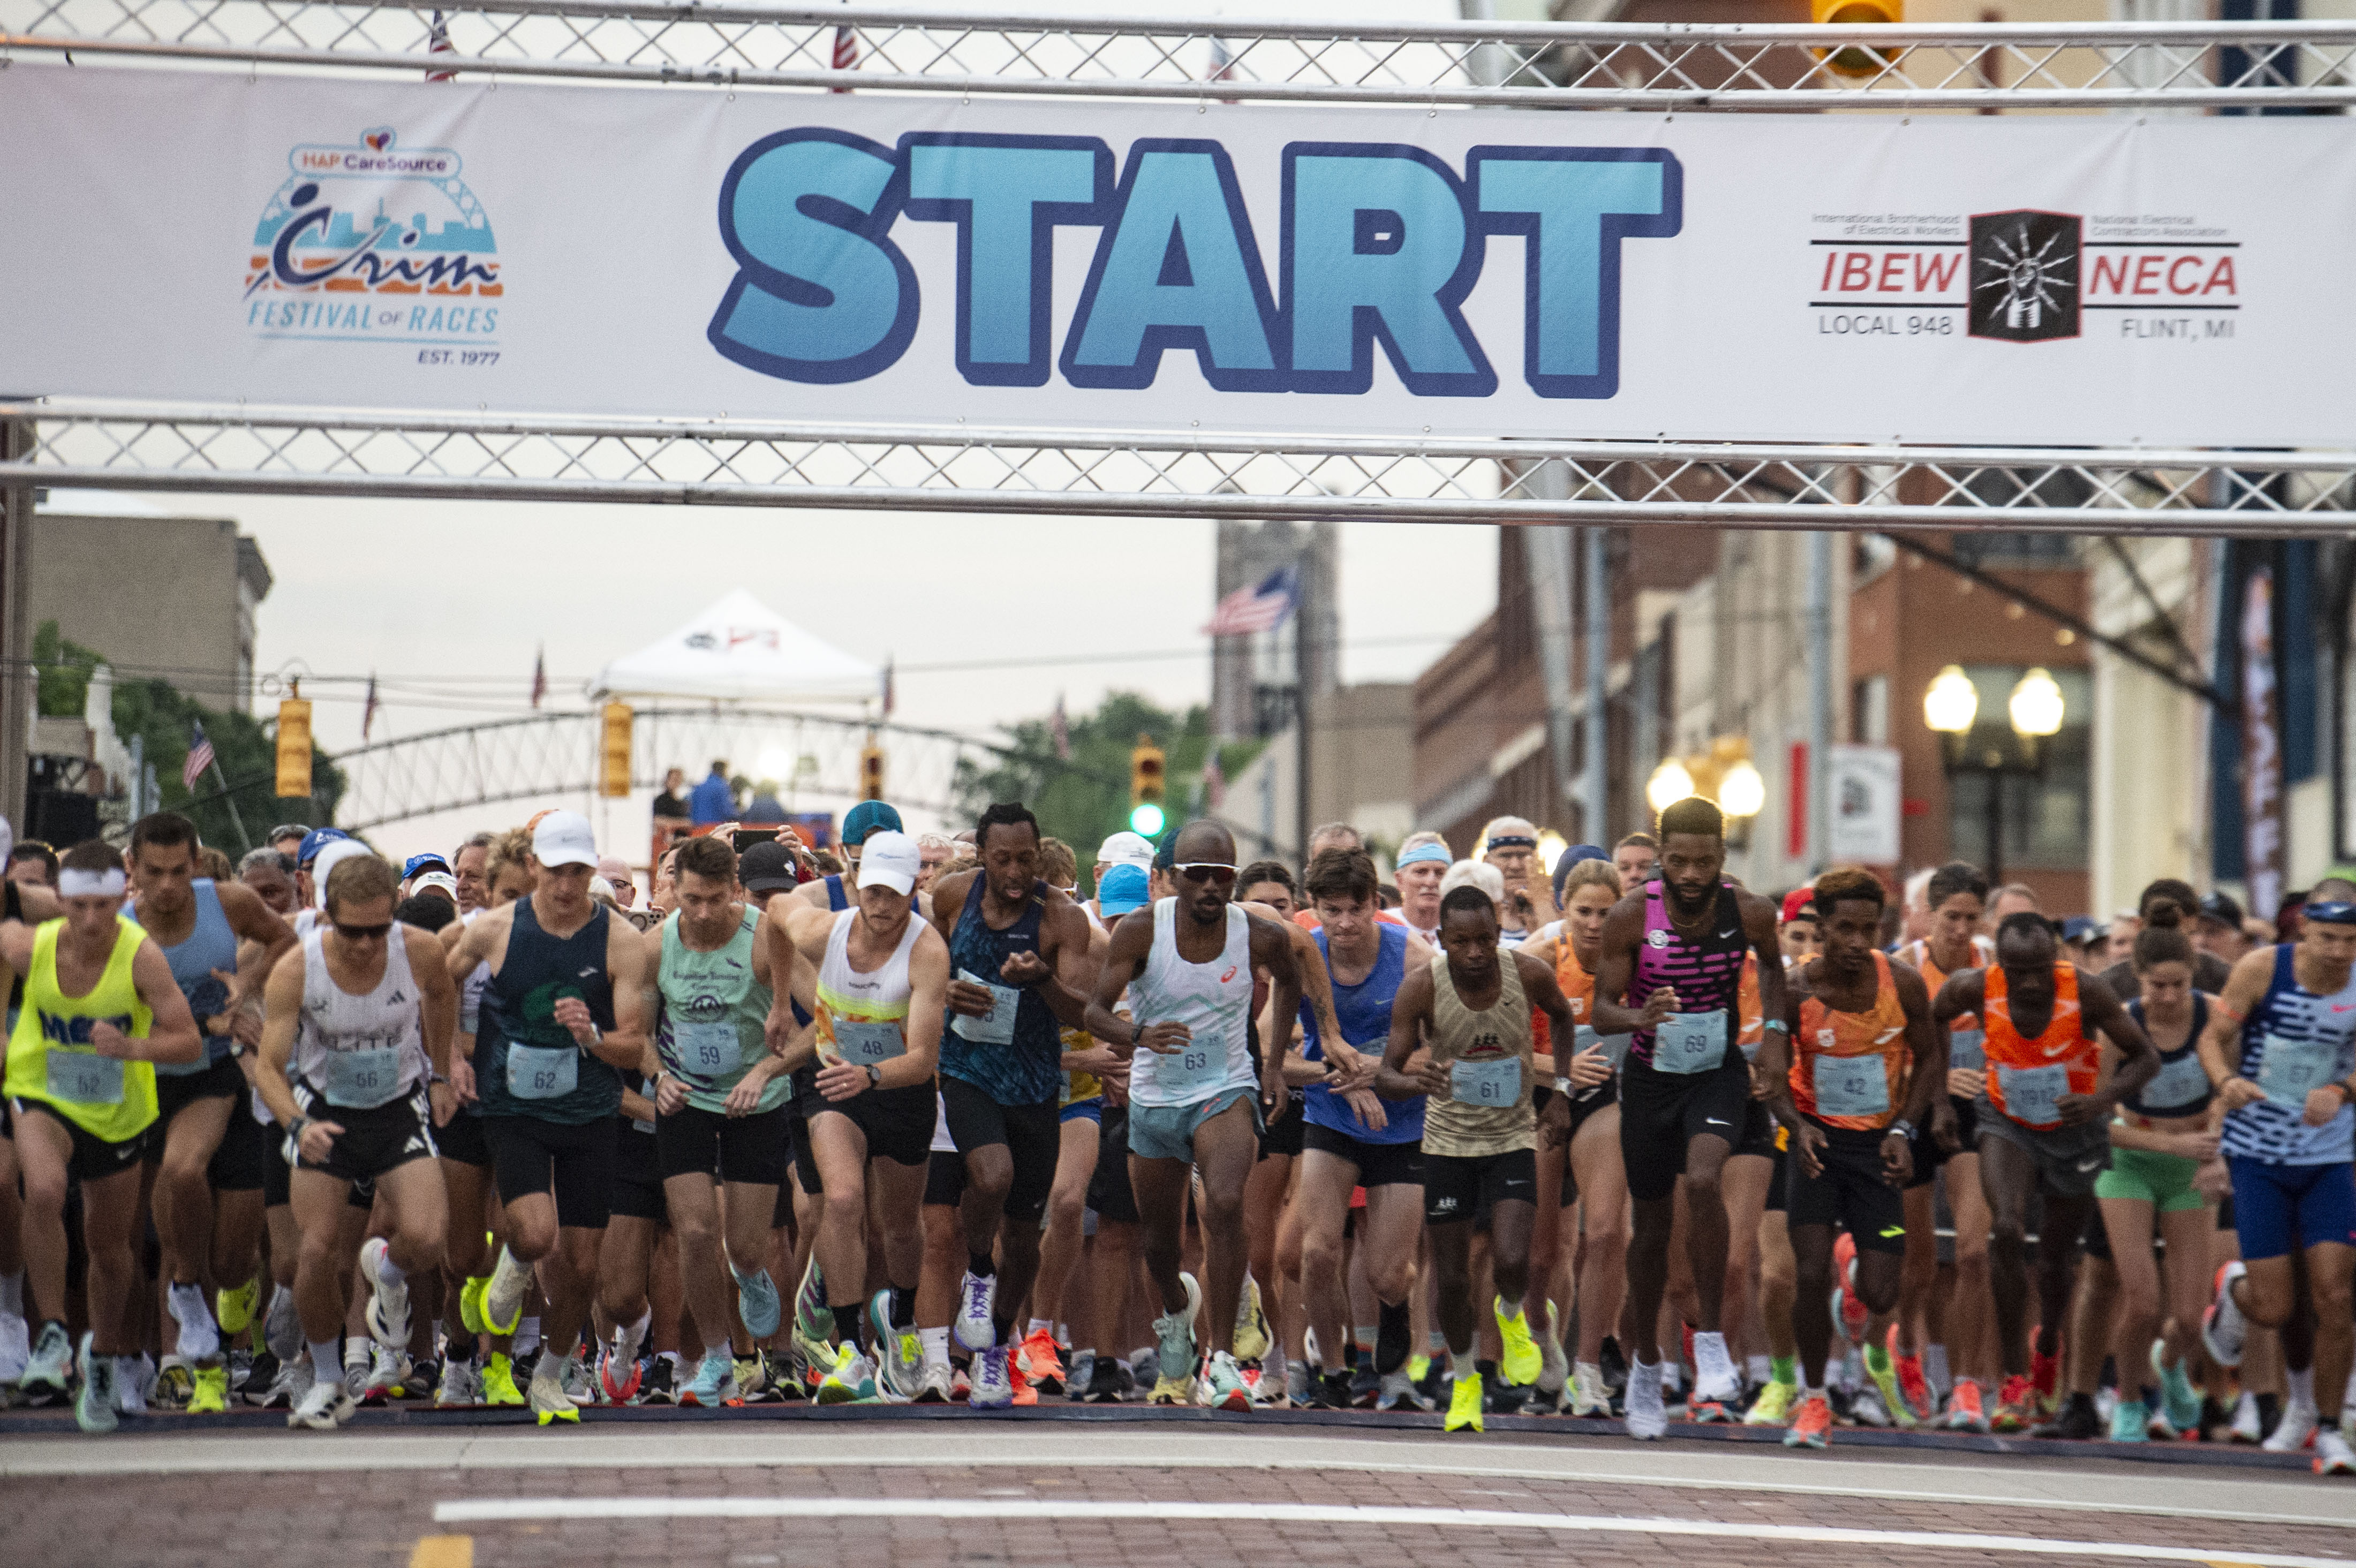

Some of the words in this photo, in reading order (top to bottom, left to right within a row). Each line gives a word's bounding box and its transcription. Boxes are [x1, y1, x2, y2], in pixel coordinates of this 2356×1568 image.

[303, 153, 340, 169] HAP
[344, 154, 447, 171] CareSource
[244, 206, 497, 301] Crim
[707, 126, 1682, 399] START
[1821, 252, 1964, 292] IBEW
[2088, 255, 2238, 297] NECA
[248, 300, 372, 330] FESTIVAL
[379, 311, 403, 325] OF
[408, 305, 499, 334] RACES
[1819, 315, 1904, 335] LOCAL
[1908, 316, 1954, 336] 948
[2121, 319, 2199, 343] FLINT,
[2205, 320, 2236, 338] MI
[418, 350, 454, 364] EST.
[460, 351, 500, 366] 1977
[862, 1040, 883, 1056] 48
[1685, 1035, 1707, 1054] 69
[699, 1046, 721, 1065] 59
[1185, 1052, 1206, 1071] 63
[534, 1071, 556, 1090] 62
[1481, 1081, 1500, 1099] 61
[1843, 1078, 1867, 1095] 42
